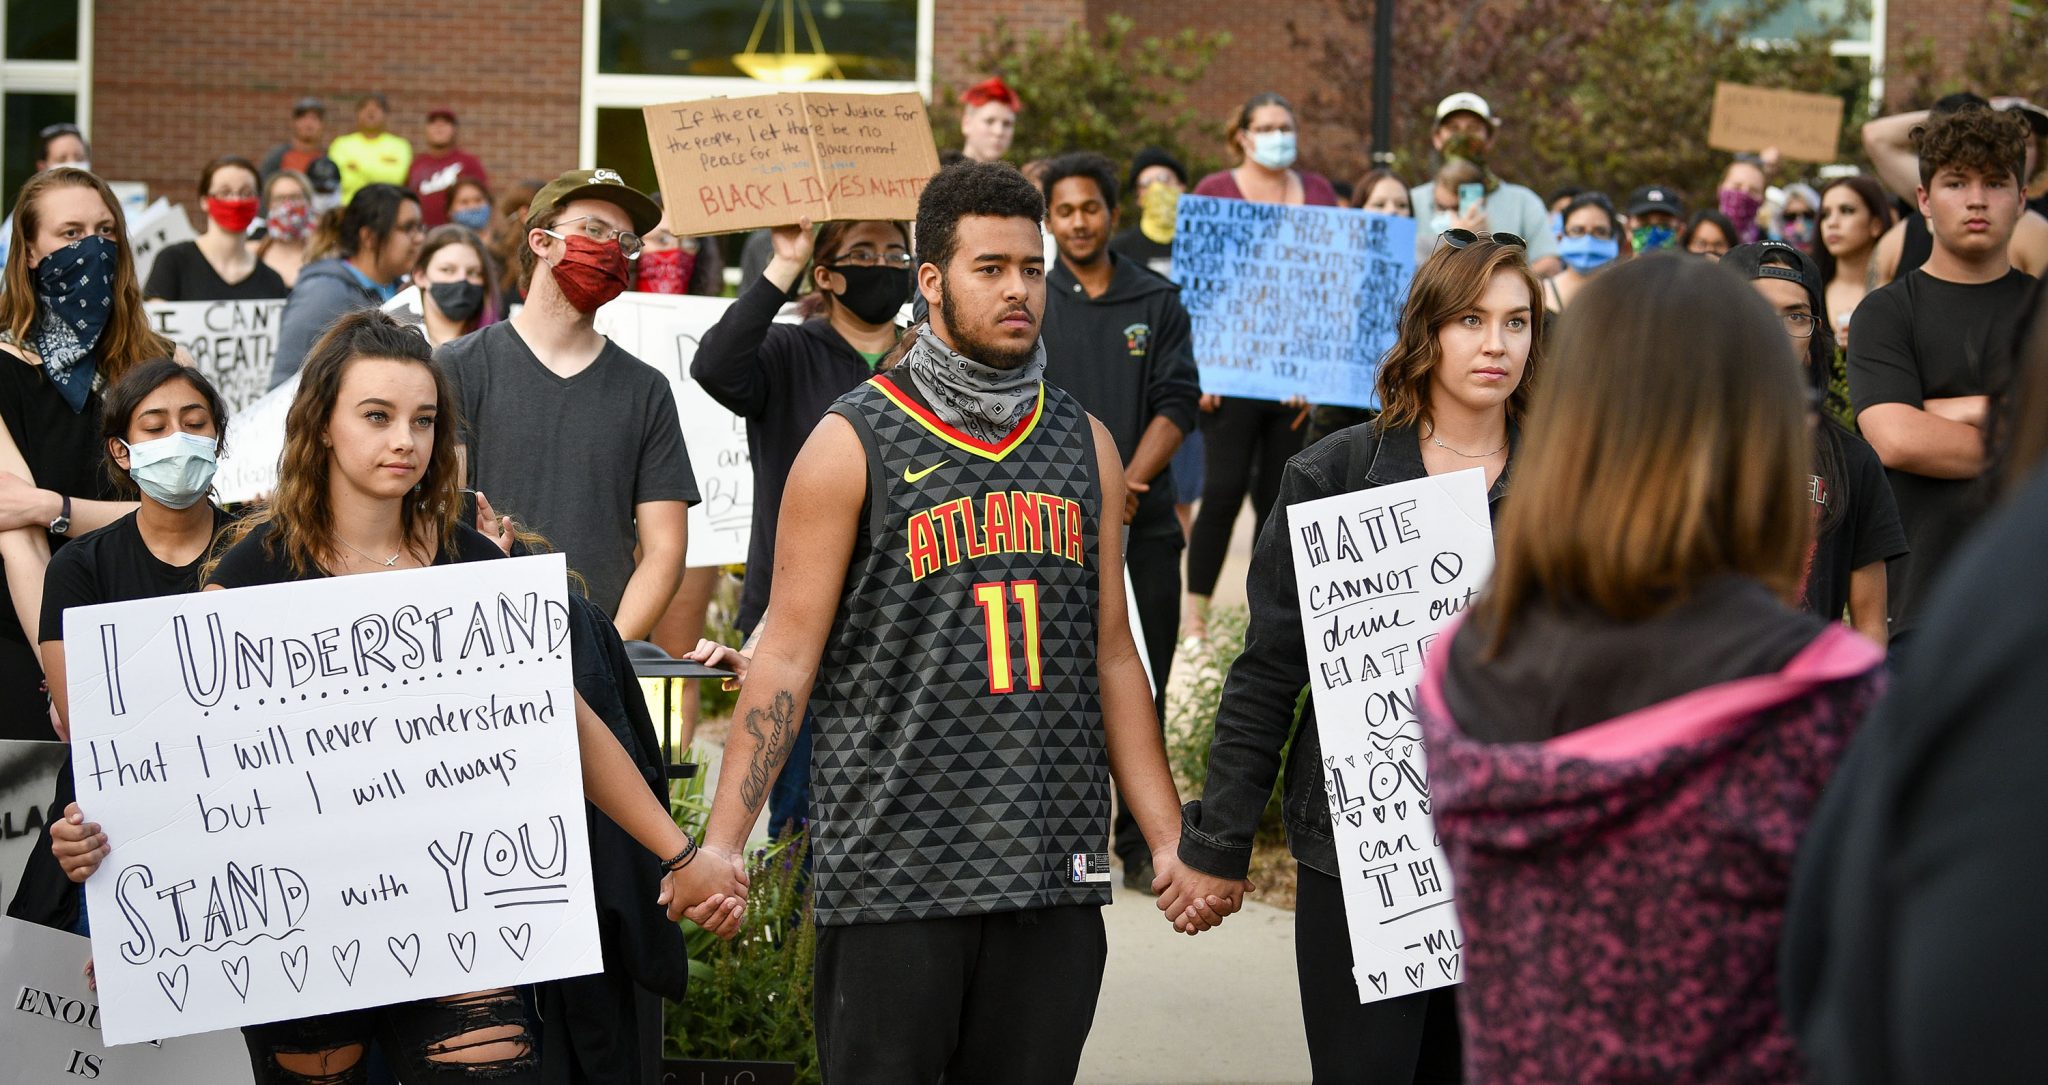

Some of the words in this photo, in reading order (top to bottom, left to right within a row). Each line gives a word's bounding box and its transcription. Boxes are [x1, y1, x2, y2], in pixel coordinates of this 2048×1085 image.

[667, 134, 692, 154] the
[748, 123, 780, 142] let
[831, 123, 849, 136] be
[859, 125, 882, 138] no
[671, 108, 704, 132] If
[712, 106, 764, 124] there
[776, 102, 794, 117] is
[806, 101, 839, 118] not
[894, 105, 918, 121] for
[750, 145, 770, 161] for
[781, 141, 800, 155] the
[816, 141, 897, 158] government
[698, 183, 776, 217] BLACK
[782, 175, 866, 206] LIVES
[870, 175, 931, 199] MATT
[1179, 199, 1220, 217] AND
[153, 310, 180, 334] I
[905, 490, 1084, 583] ATLANTA
[1301, 498, 1421, 568] HATE
[1309, 565, 1420, 612] CANNOT
[973, 579, 1043, 695] 11
[1323, 607, 1415, 653] drive
[1429, 587, 1480, 621] out
[99, 622, 127, 716] I
[172, 591, 571, 709] UNDERSTAND
[1365, 684, 1419, 728] ON
[89, 740, 169, 791] that
[196, 734, 211, 778] I
[233, 724, 295, 770] will
[304, 715, 379, 758] never
[395, 689, 556, 745] understand
[196, 787, 272, 833] but
[305, 770, 323, 815] I
[352, 767, 406, 805] will
[424, 747, 518, 787] always
[1332, 758, 1430, 814] LOV
[1359, 834, 1421, 863] can
[114, 861, 310, 965] STAND
[340, 872, 410, 909] with
[427, 815, 568, 914] YOU
[1362, 857, 1443, 908] TH
[1404, 928, 1464, 955] -ML
[17, 986, 103, 1030] ENOU
[67, 1049, 103, 1080] IS
